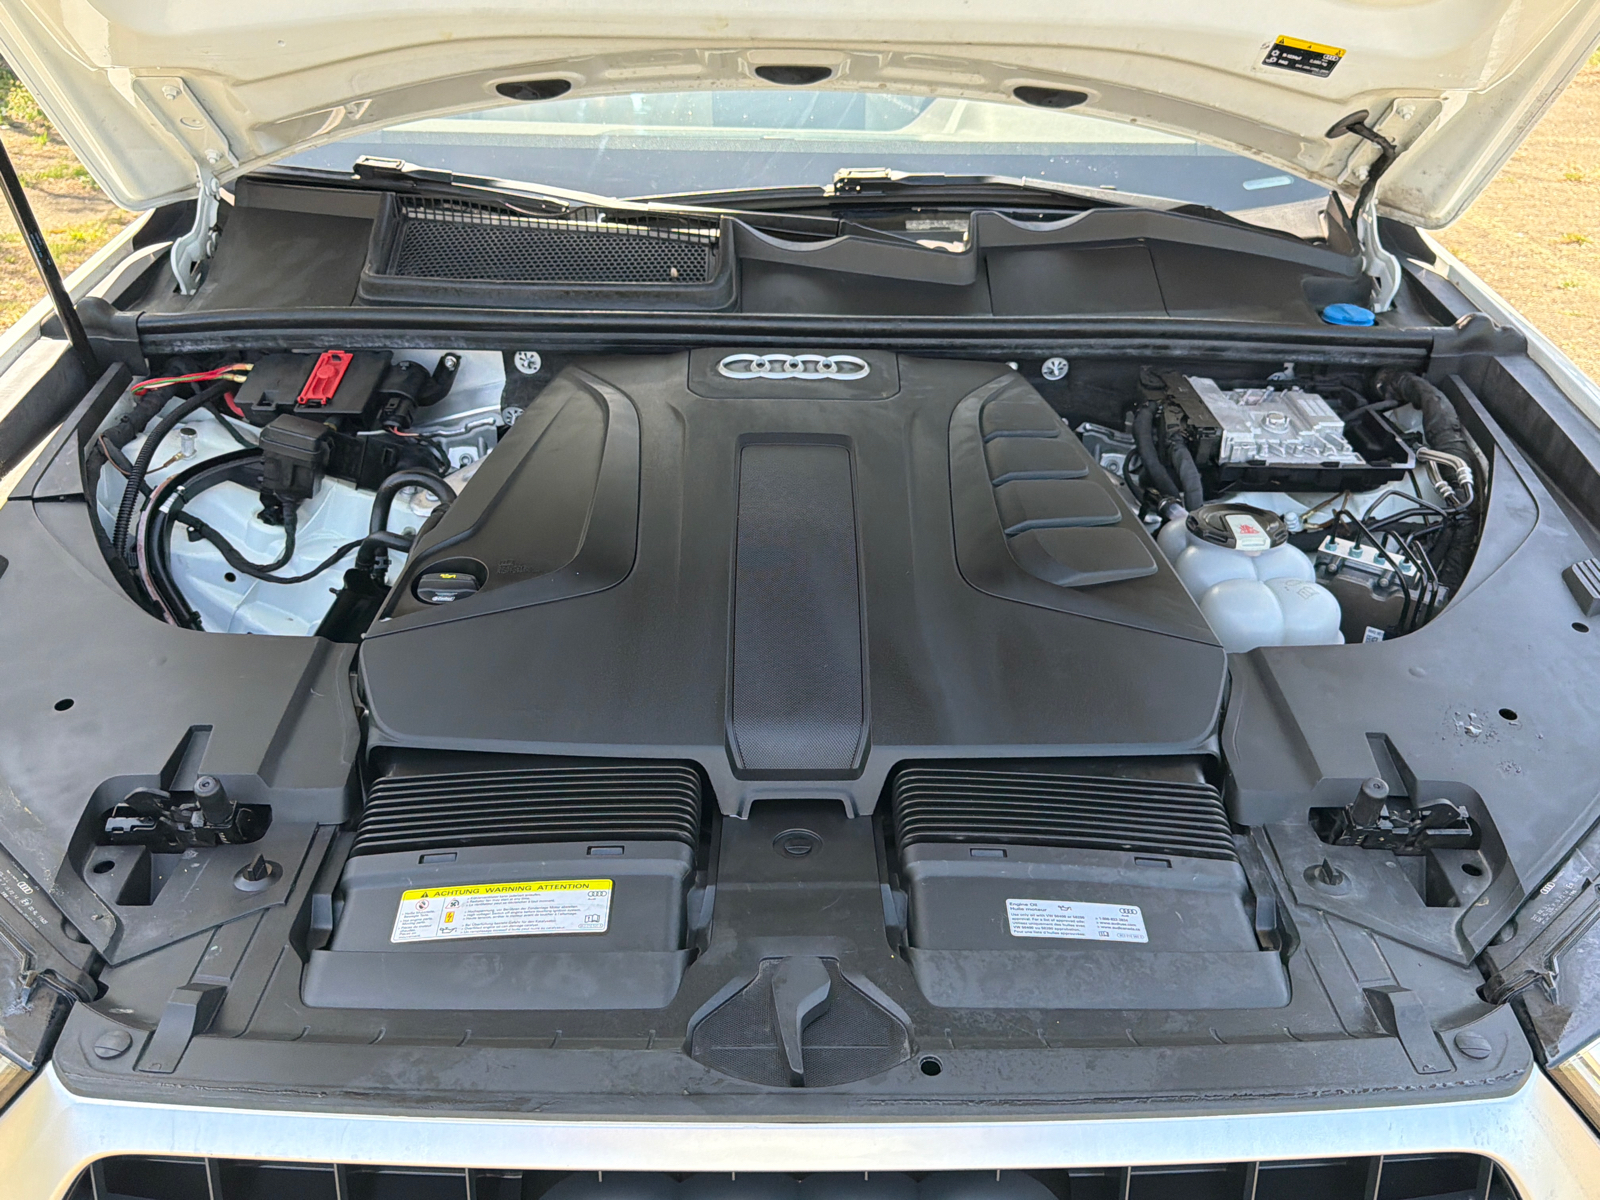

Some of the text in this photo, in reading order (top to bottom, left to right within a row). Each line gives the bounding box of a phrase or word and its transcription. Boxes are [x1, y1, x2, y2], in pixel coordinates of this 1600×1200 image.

[434, 883, 590, 897] ACHTUNG WARNING ATTENTION
